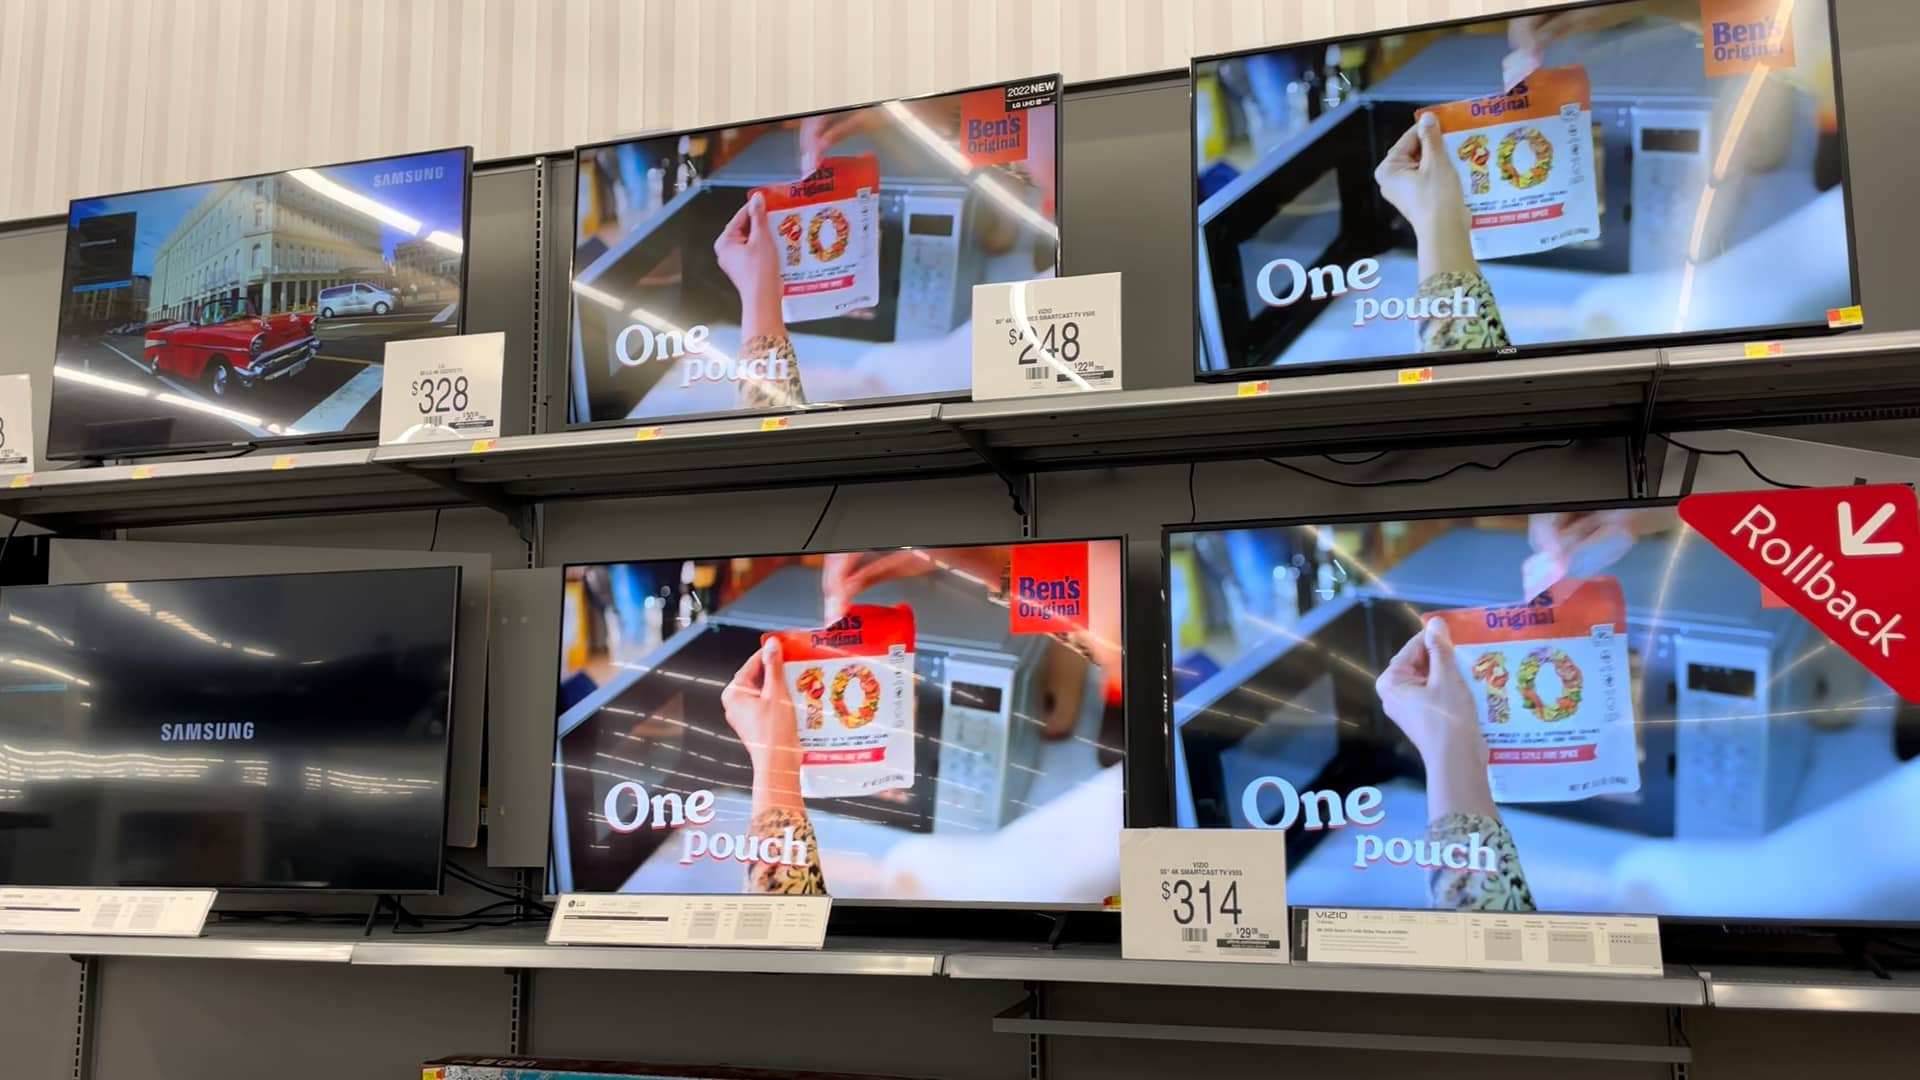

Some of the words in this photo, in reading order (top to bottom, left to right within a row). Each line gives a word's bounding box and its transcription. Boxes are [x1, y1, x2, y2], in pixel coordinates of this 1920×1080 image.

[1007, 86, 1031, 97] 2022
[1030, 81, 1056, 94] NEW
[1471, 96, 1529, 117] Original
[968, 114, 1021, 141] Ben's
[968, 134, 1020, 155] Original
[373, 166, 444, 188] SAMSUNG
[1457, 127, 1554, 195] 10
[777, 207, 850, 267] 10
[1256, 257, 1381, 308] One
[1352, 286, 1478, 328] pouch
[615, 323, 711, 367] One
[679, 347, 790, 388] pouch
[411, 375, 469, 415] $328
[1018, 575, 1080, 601] Ben's
[1730, 503, 1907, 658] Rollback
[1018, 600, 1080, 620] Original
[1486, 607, 1554, 631] Original
[795, 662, 881, 730] 10
[1472, 647, 1583, 724] 10
[160, 721, 255, 741] SAMSUNG
[604, 781, 716, 834] One
[1241, 775, 1386, 832] One
[679, 825, 809, 868] pouch
[1353, 831, 1498, 876] pouch
[1161, 879, 1243, 925] $314
[1315, 911, 1348, 920] VIZIO
